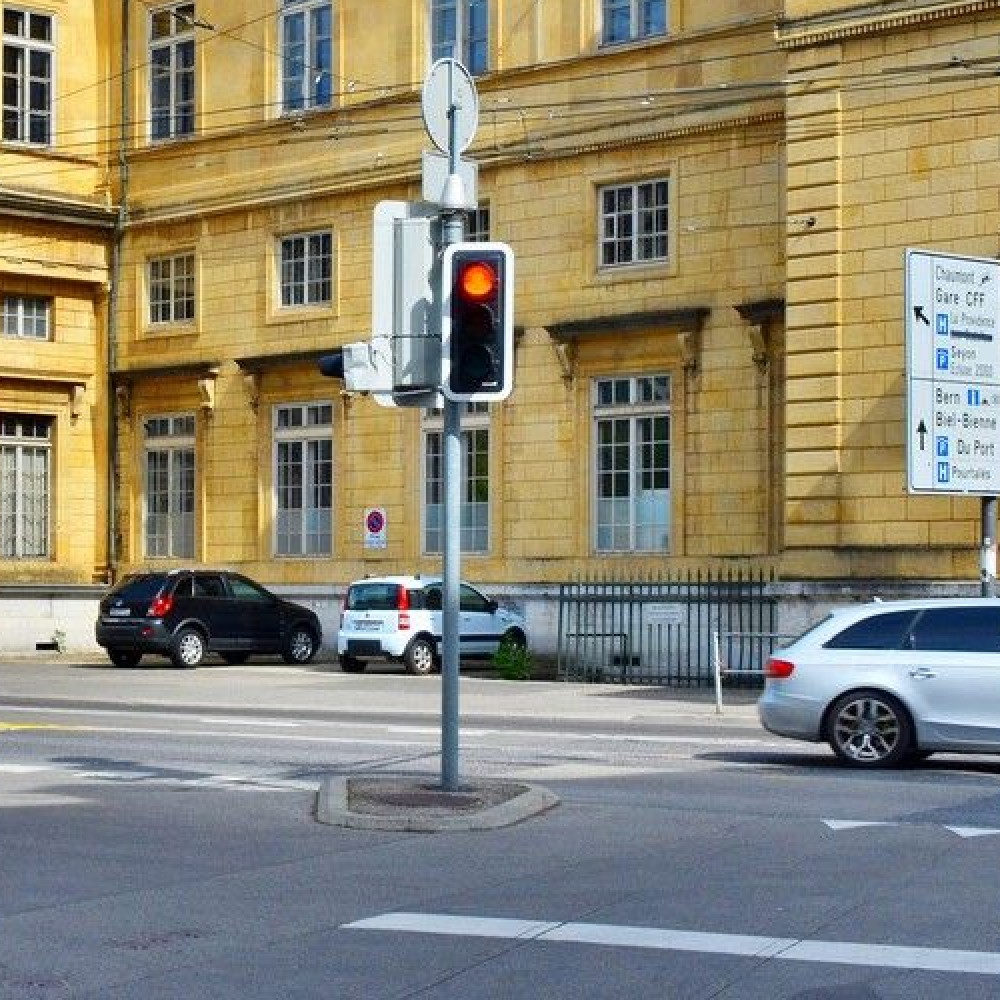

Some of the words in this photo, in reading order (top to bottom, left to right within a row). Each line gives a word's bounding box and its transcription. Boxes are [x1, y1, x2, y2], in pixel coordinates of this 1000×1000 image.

[936, 287, 959, 304] Gare
[965, 291, 985, 308] CFF
[936, 387, 960, 405] Bern
